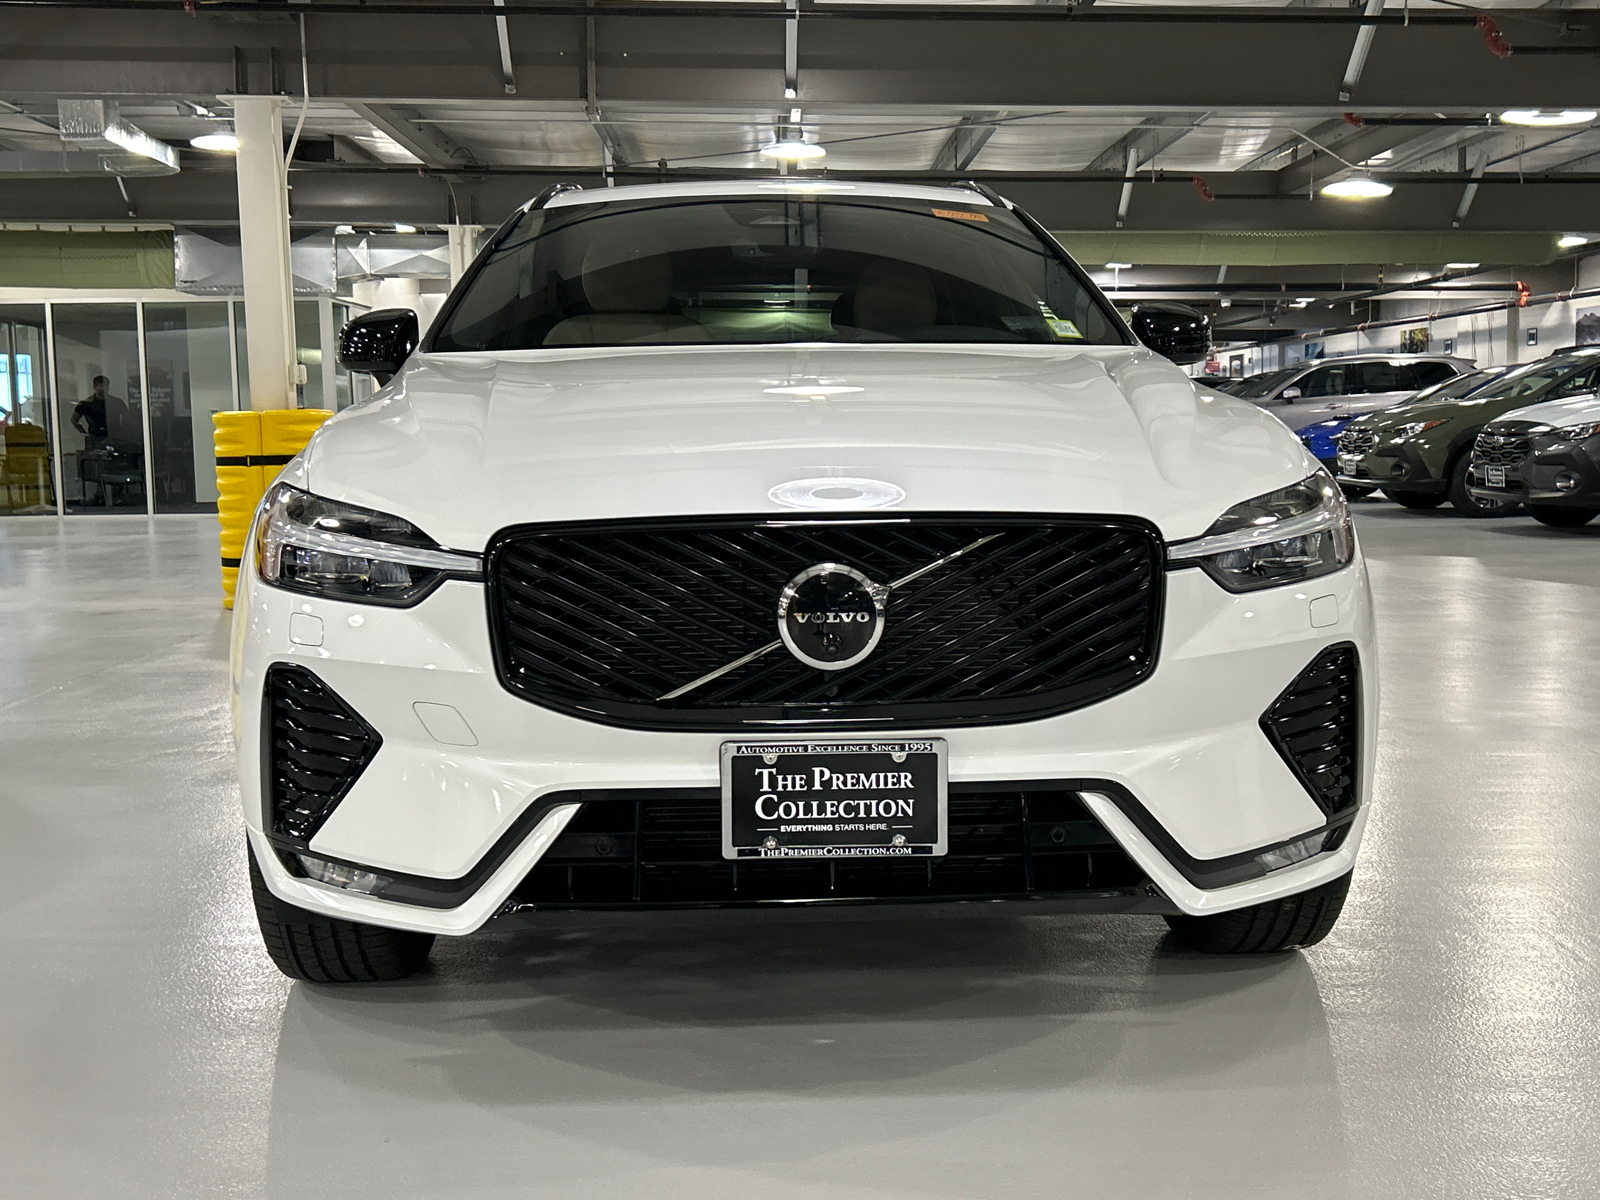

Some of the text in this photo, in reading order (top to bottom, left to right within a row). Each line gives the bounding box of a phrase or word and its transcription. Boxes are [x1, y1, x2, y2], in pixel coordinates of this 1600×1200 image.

[793, 611, 870, 623] VOLVO
[807, 744, 869, 753] EXCELLENCE
[871, 743, 901, 752] SINCE
[904, 743, 931, 751] 1995
[755, 767, 914, 791] THE PREMIER
[754, 794, 915, 820] COLLECTION
[780, 824, 833, 832] EVERYTHING
[834, 823, 865, 831] STARTS
